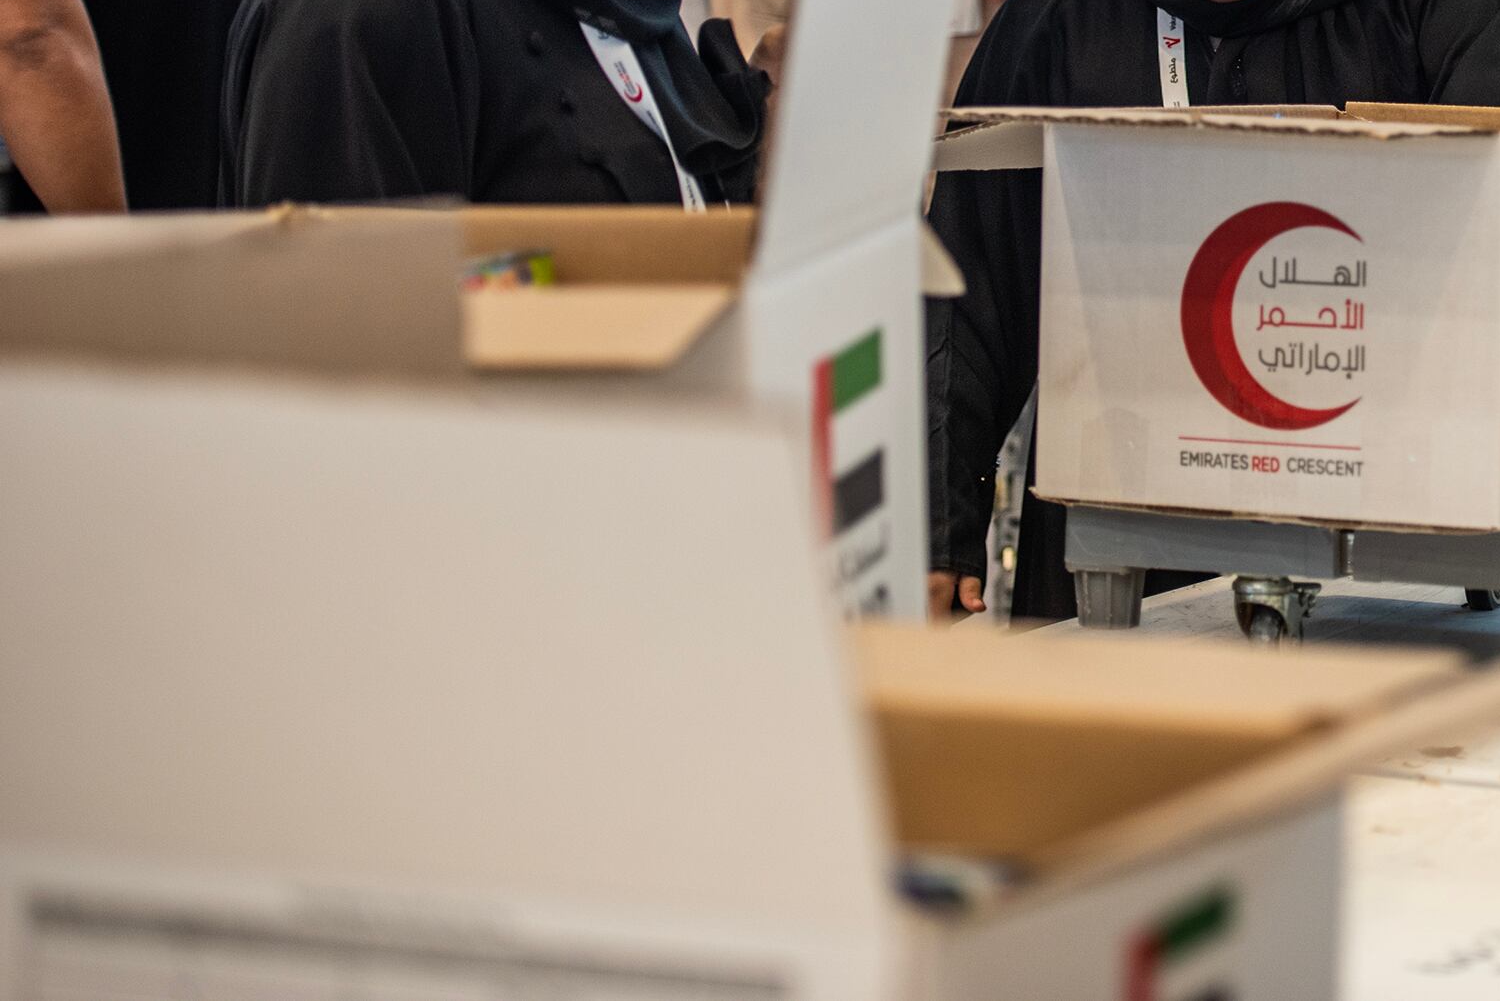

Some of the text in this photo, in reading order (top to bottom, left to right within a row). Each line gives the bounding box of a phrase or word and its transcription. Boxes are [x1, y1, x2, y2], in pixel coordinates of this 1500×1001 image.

[1258, 256, 1367, 289] الهلال
[1255, 297, 1365, 332] الأحمر
[1257, 341, 1366, 380] الإماراتي
[1179, 450, 1364, 477] EMIRATES RED CRESCENT
